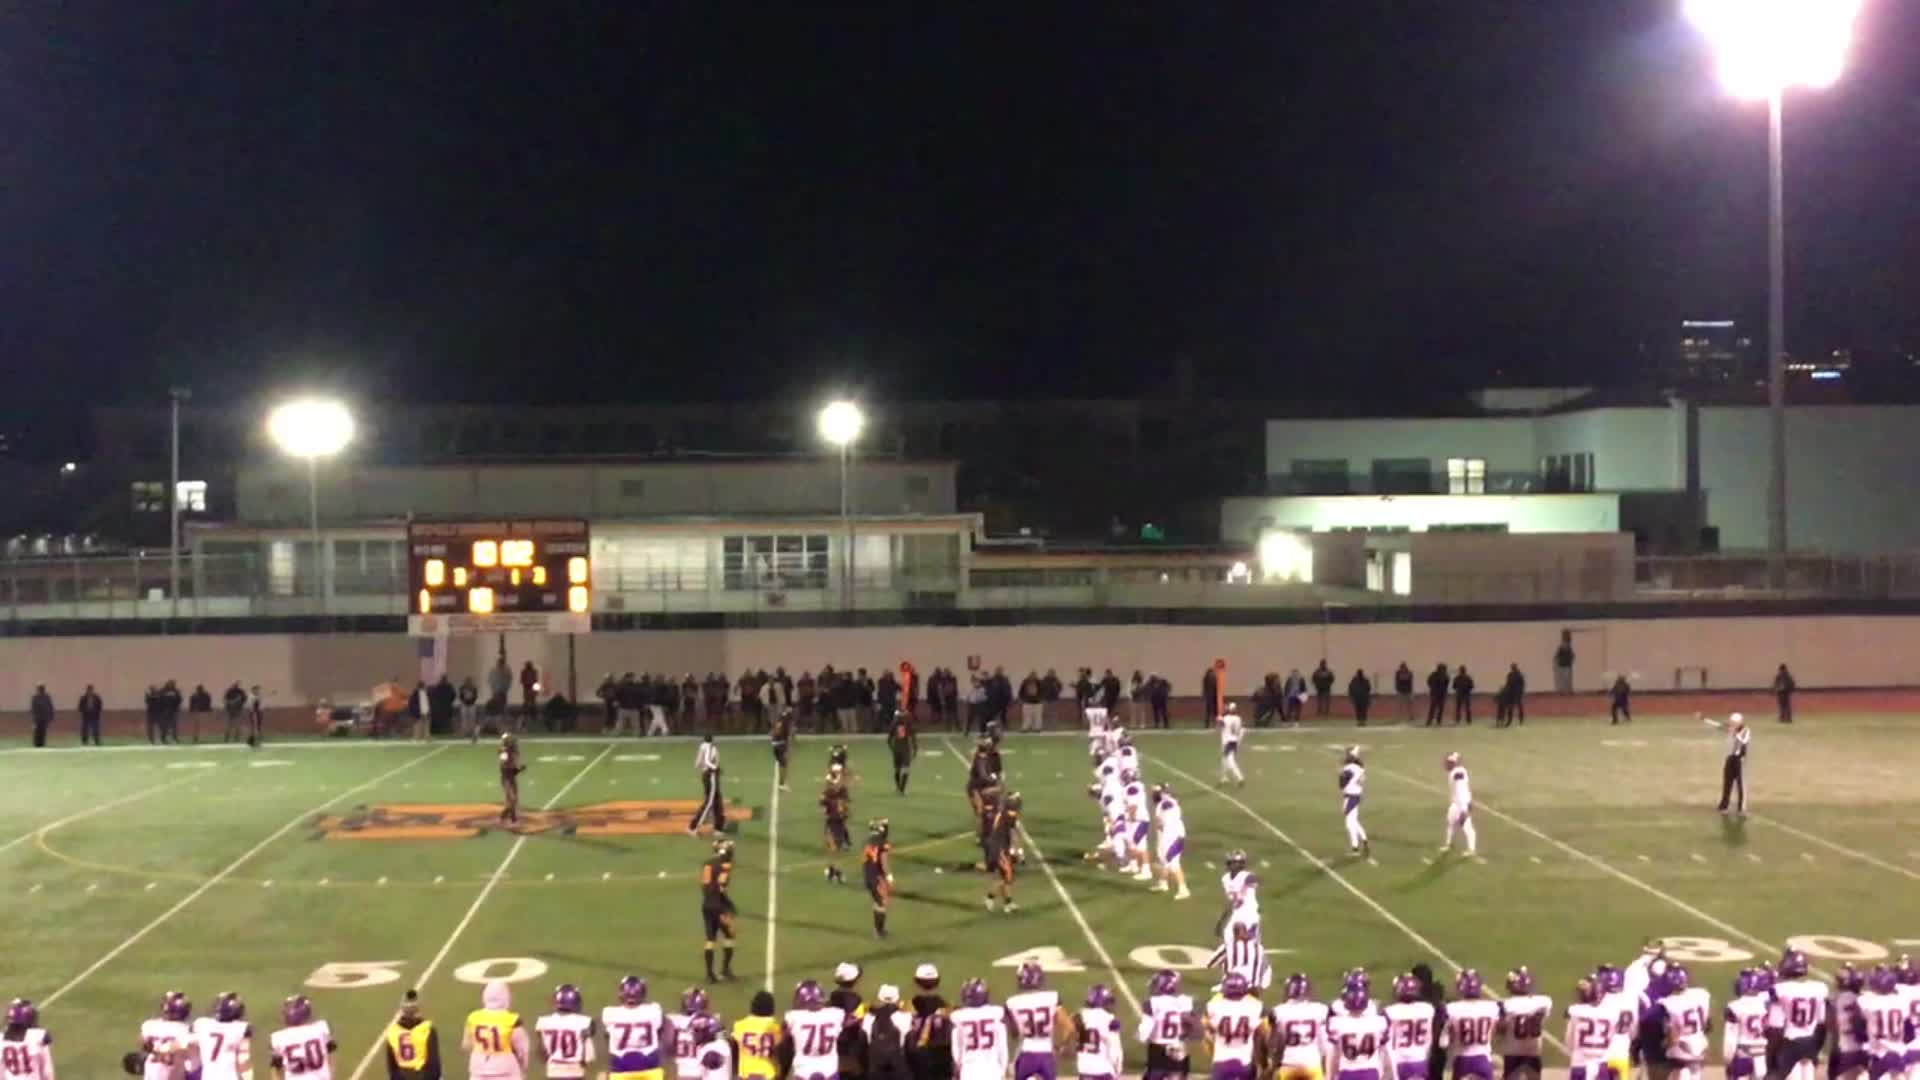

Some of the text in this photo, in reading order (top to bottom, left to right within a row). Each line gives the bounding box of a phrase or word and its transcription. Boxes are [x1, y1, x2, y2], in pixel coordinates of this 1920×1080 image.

[304, 957, 548, 989] 50
[474, 1025, 501, 1052] 51
[612, 1022, 652, 1051] 73
[961, 1019, 995, 1051] 35
[1017, 1007, 1050, 1039] 32
[1217, 1015, 1250, 1045] 44
[1577, 1016, 1609, 1049] 23
[209, 1032, 224, 1062] 7
[397, 1032, 414, 1061] 6
[543, 1028, 576, 1058] 70
[801, 1023, 835, 1056] 76
[284, 1038, 324, 1074] 50
